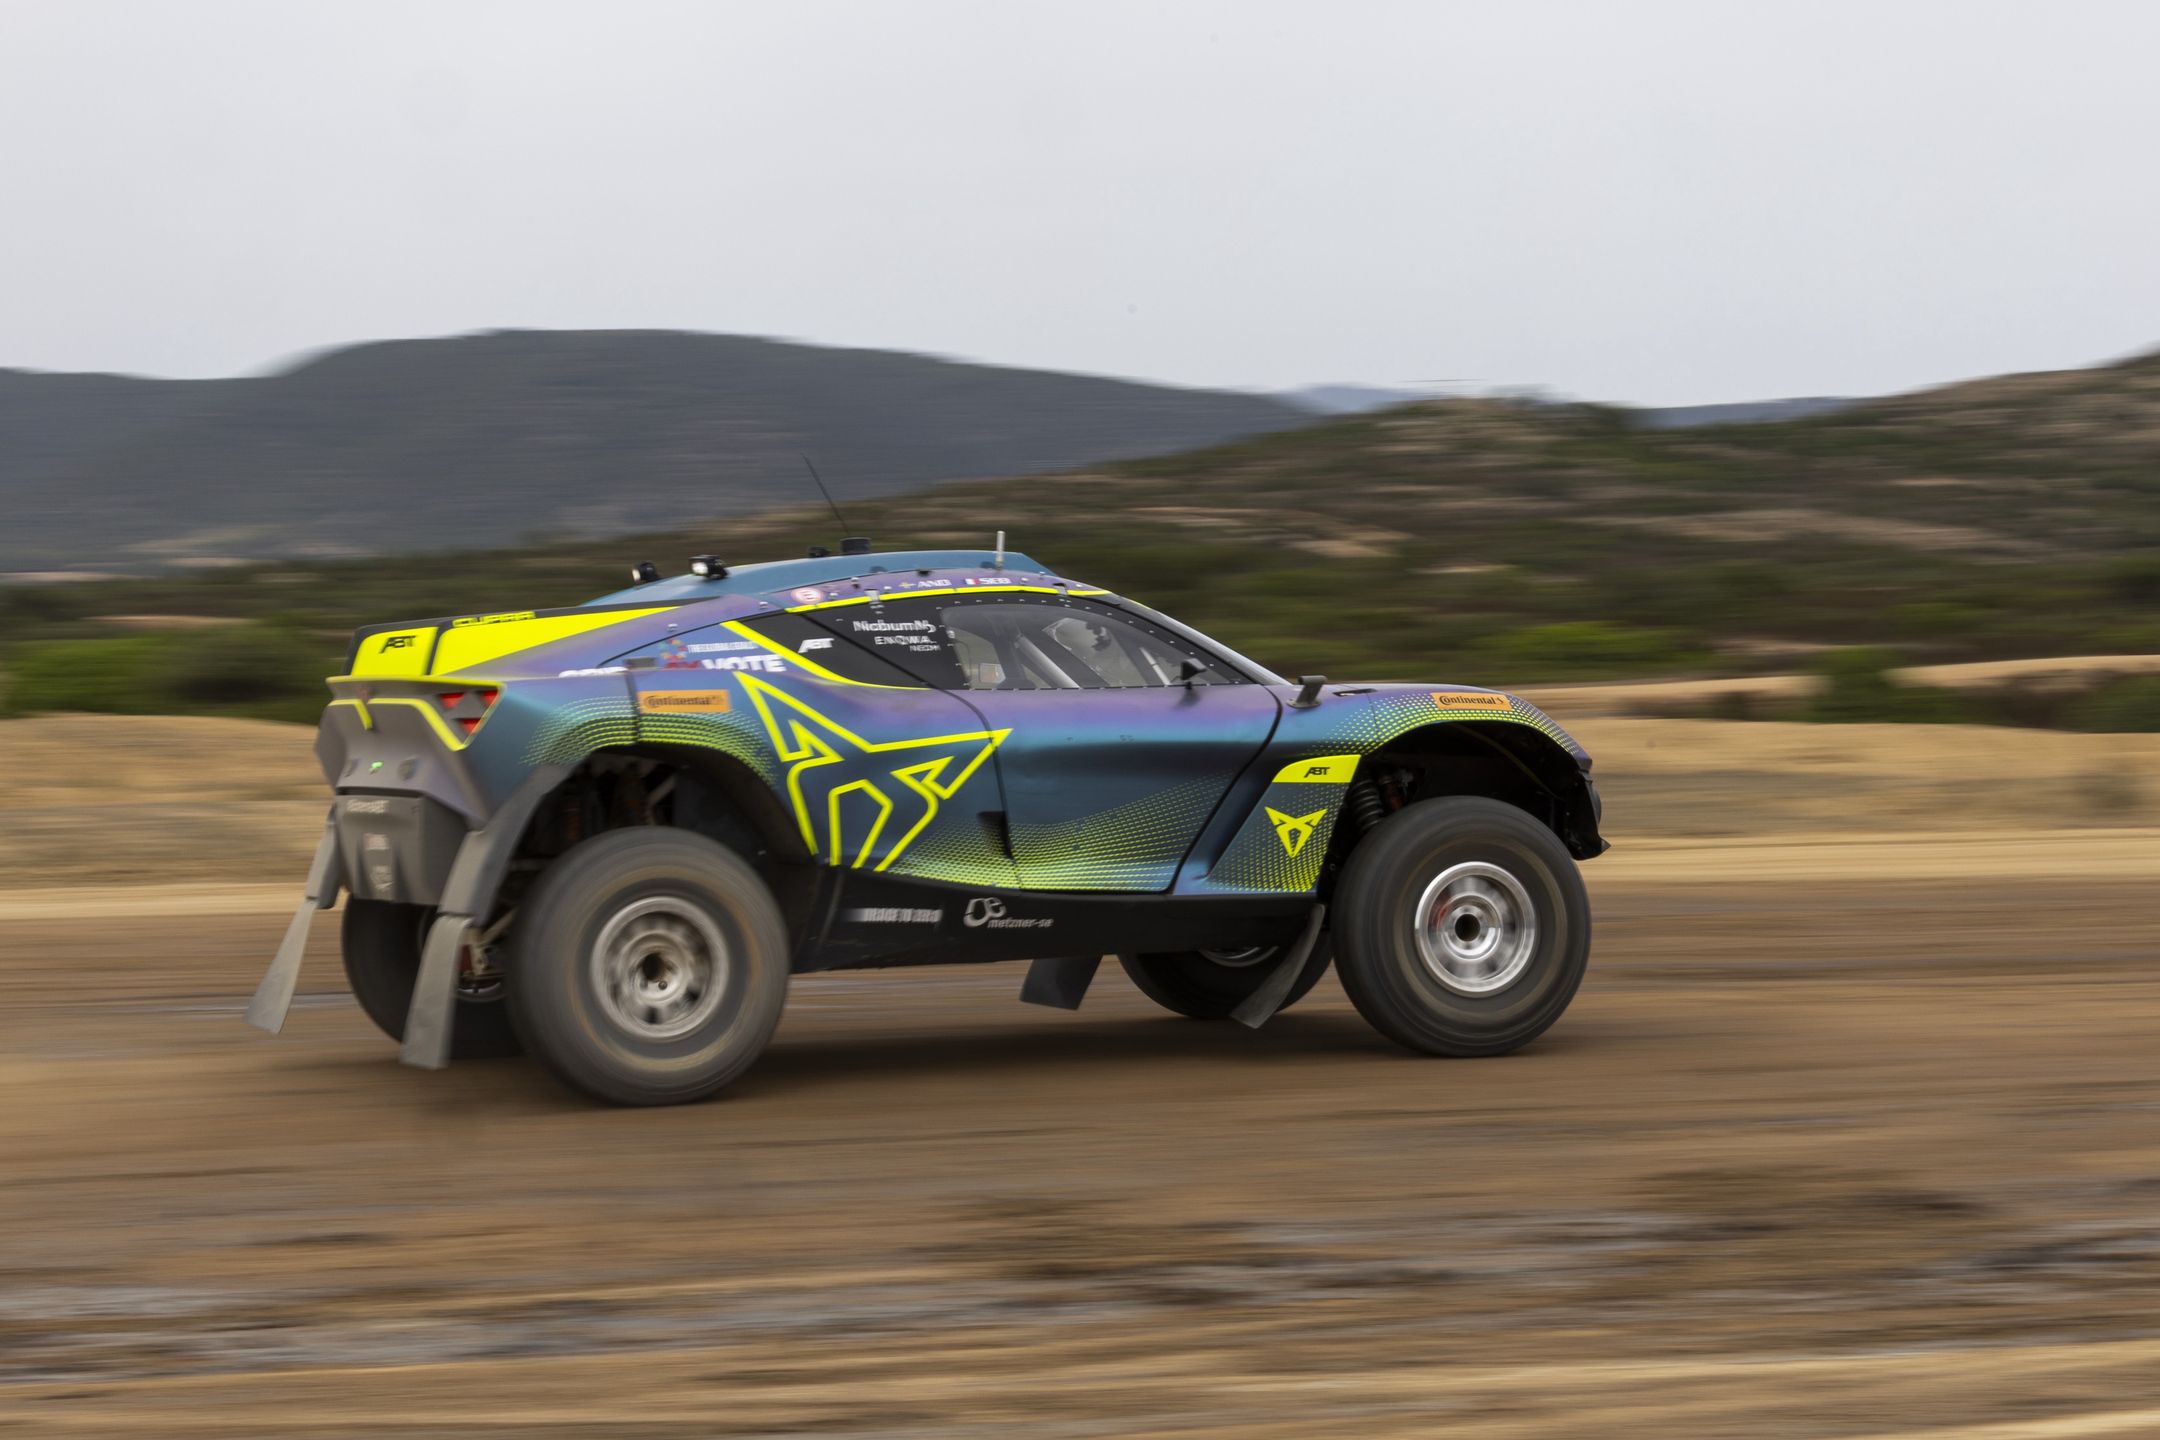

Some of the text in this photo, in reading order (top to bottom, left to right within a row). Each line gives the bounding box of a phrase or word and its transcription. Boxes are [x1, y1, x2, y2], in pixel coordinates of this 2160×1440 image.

[379, 635, 417, 654] ABT
[798, 638, 834, 653] ABT
[701, 654, 787, 672] VOTE
[1439, 695, 1497, 705] Continental
[1304, 767, 1330, 778] ABT
[988, 917, 1054, 928] metzner-se
